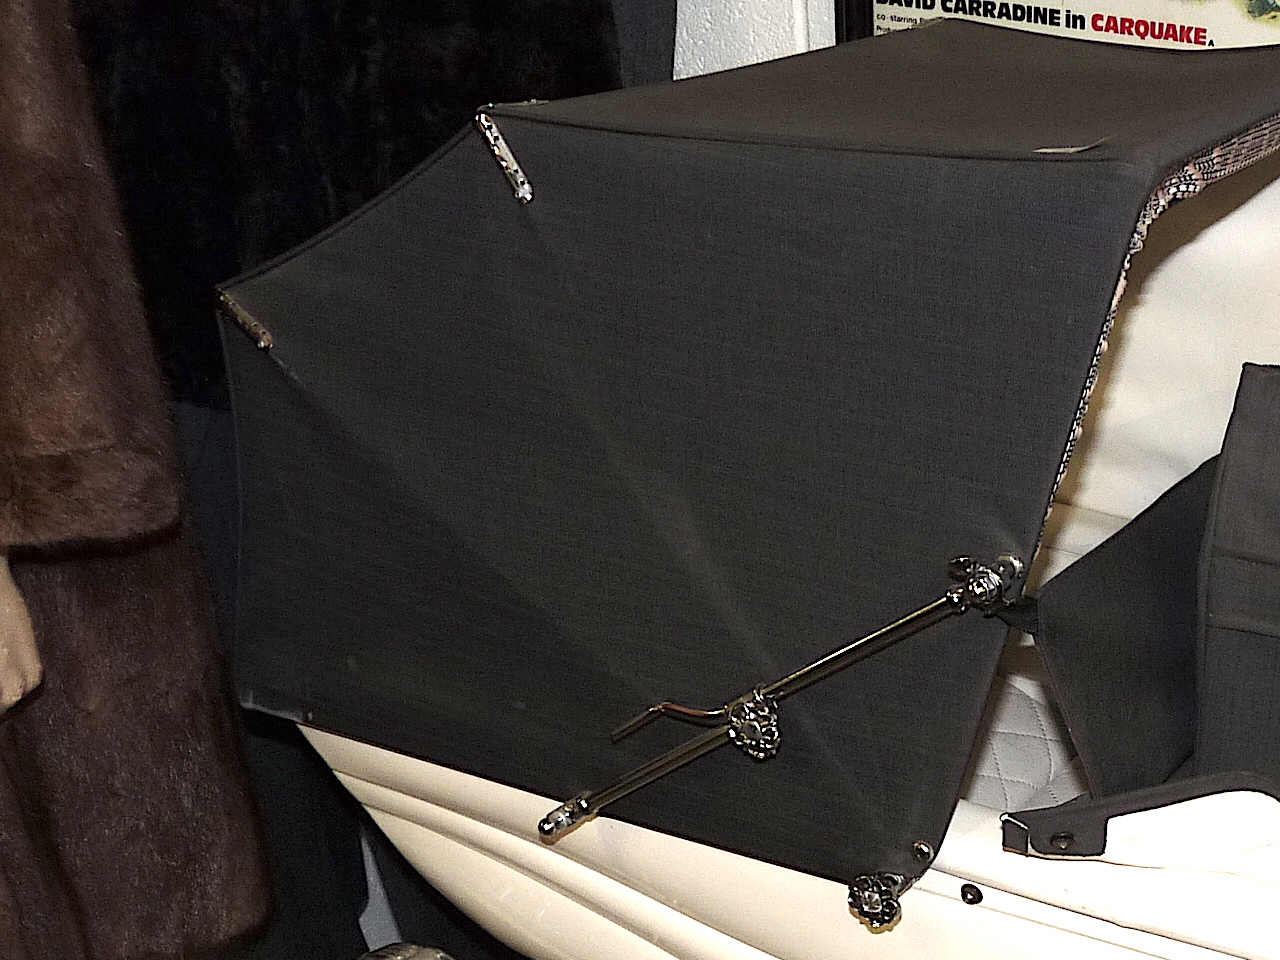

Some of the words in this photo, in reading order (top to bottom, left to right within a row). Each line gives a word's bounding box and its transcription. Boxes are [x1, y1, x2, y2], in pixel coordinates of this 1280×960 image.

[941, 0, 1061, 27] CARRADINE
[1065, 9, 1086, 30] in
[1091, 13, 1208, 46] CARQUAKE
